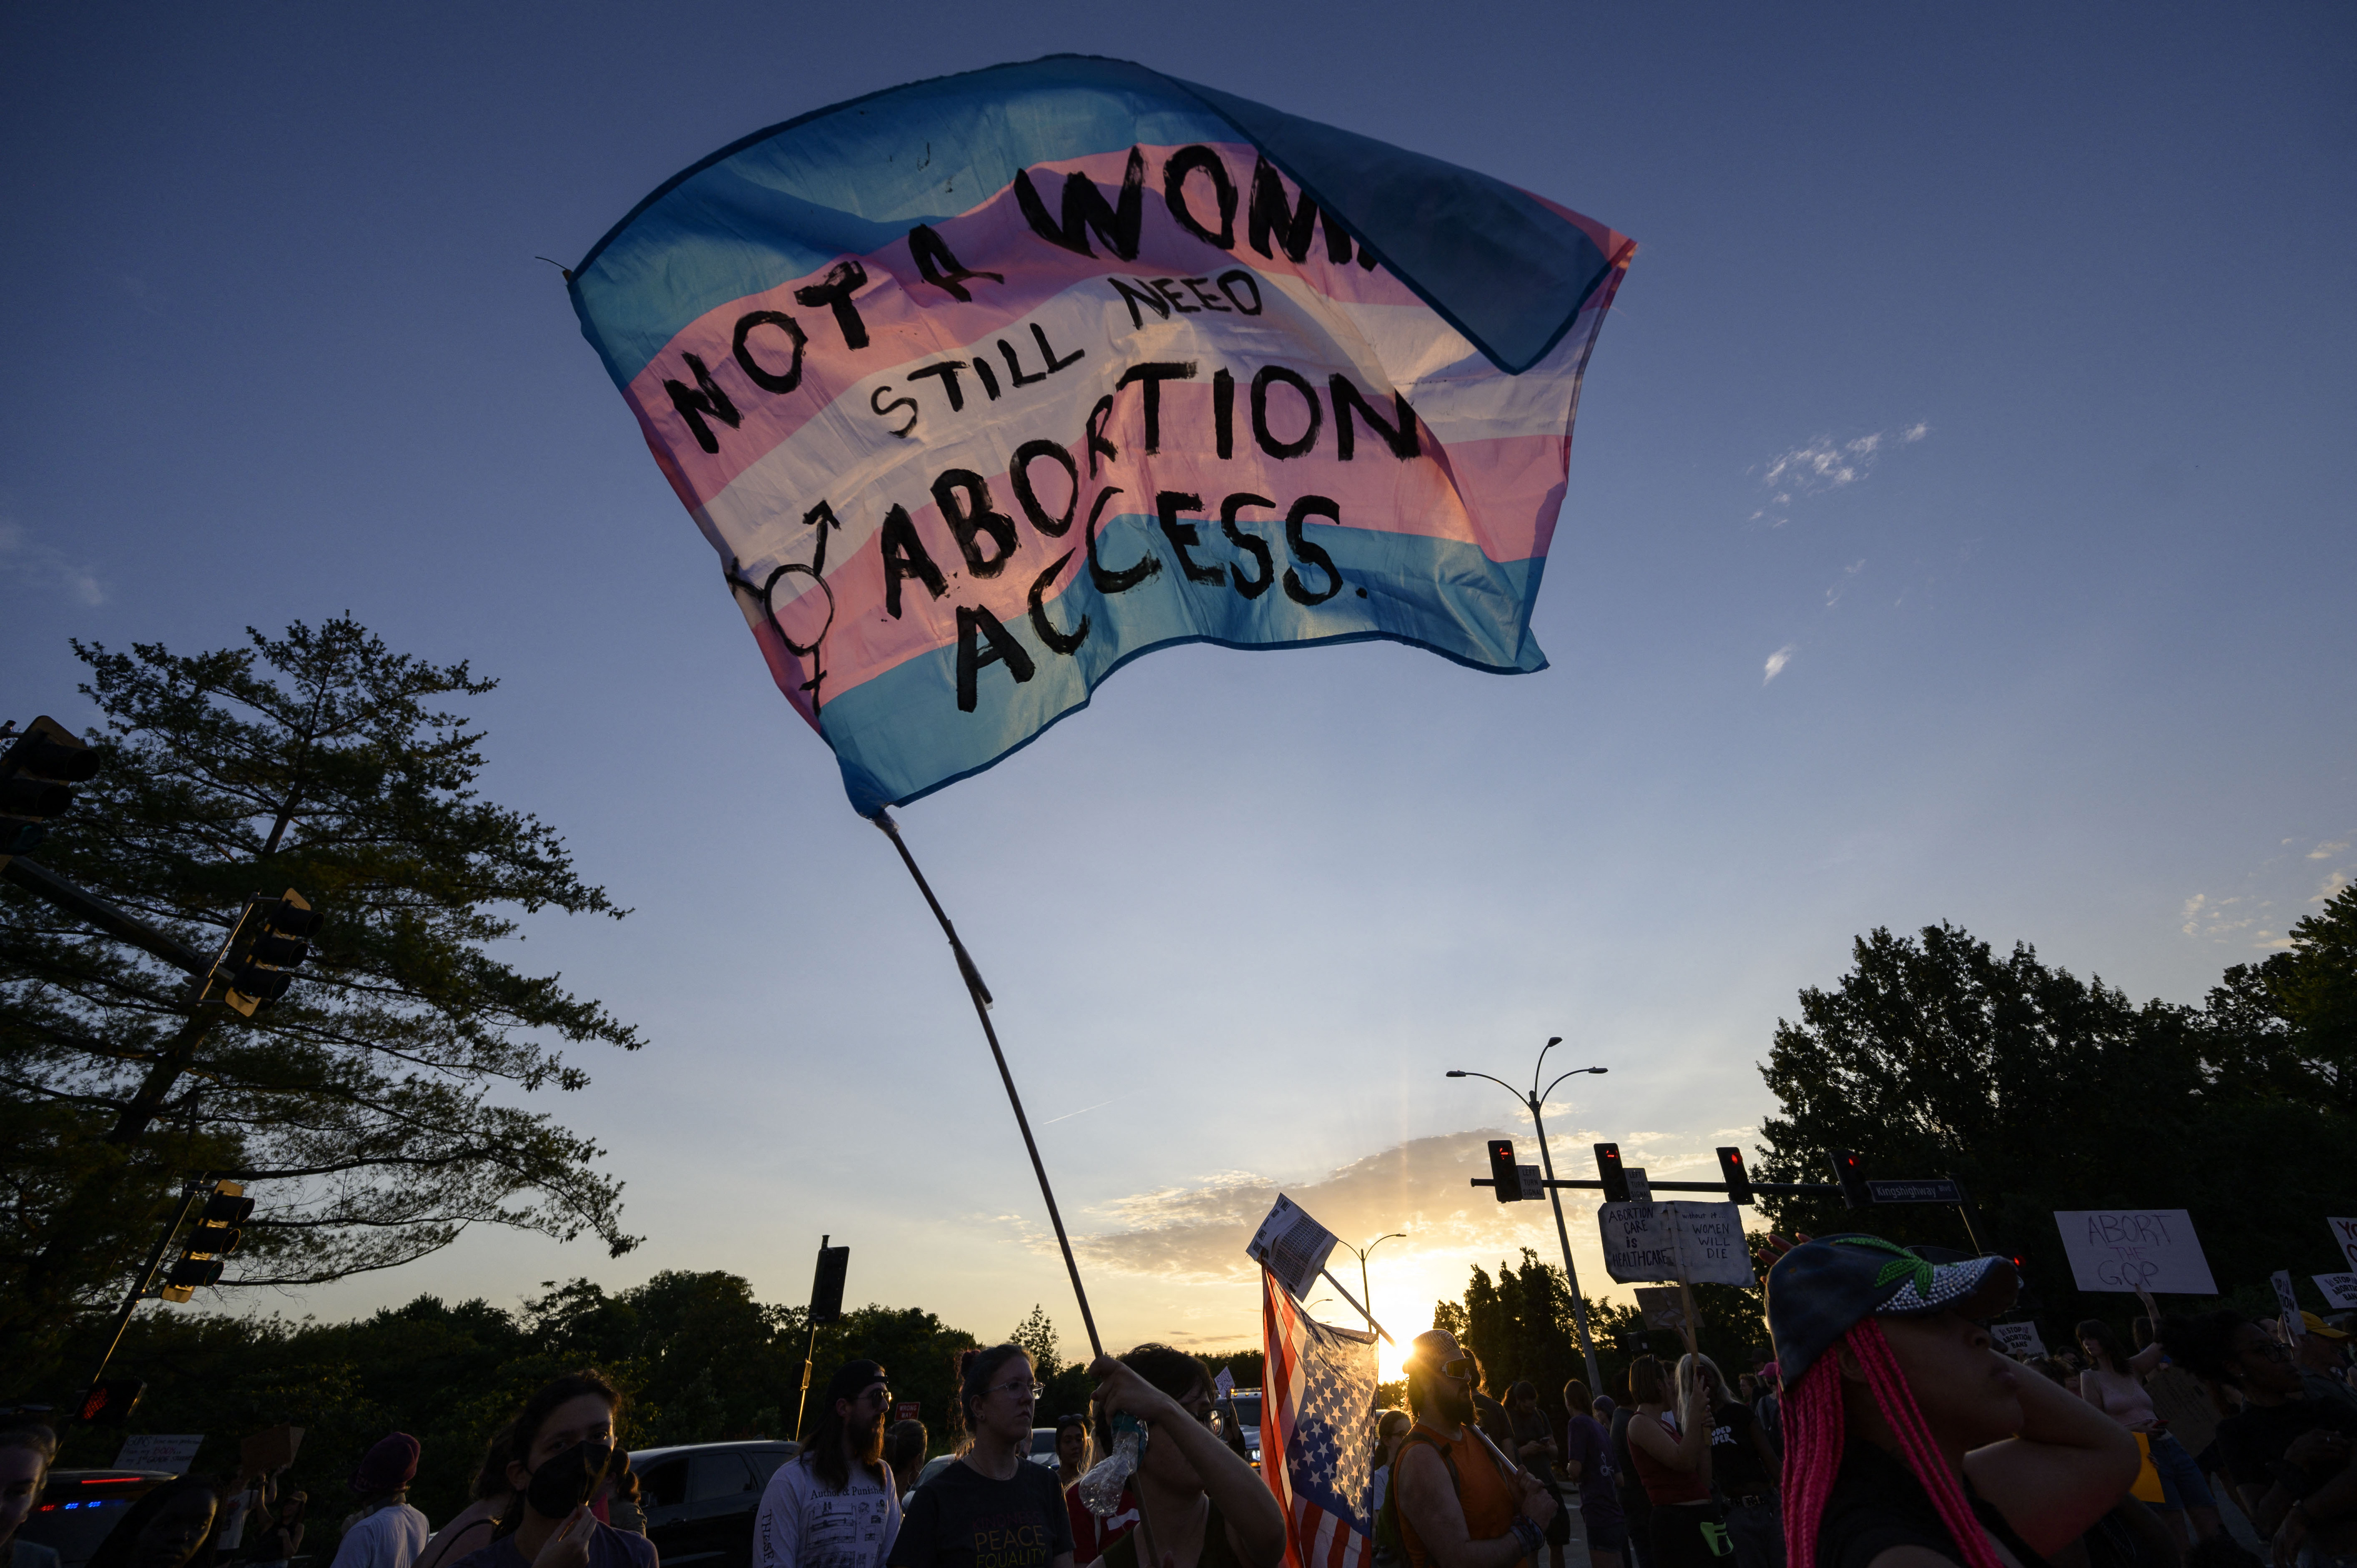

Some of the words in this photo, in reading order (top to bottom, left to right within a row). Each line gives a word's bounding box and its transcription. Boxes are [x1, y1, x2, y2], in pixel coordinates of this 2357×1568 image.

[663, 261, 869, 454] NOT
[909, 223, 1004, 302] A
[1014, 145, 1378, 271] WOM
[871, 324, 1084, 438] STILL
[1108, 269, 1262, 330] NEED
[881, 362, 1421, 620] ABORTION
[956, 486, 1368, 712] ACCESS.
[1876, 1187, 1937, 1198] Kingshighway
[1609, 1207, 1654, 1223] ABORTION
[1624, 1220, 1648, 1234] CARE
[1692, 1224, 1729, 1234] WOMEN
[2088, 1214, 2172, 1246] ABORT
[1627, 1237, 1637, 1248] is
[1698, 1237, 1730, 1246] WILL
[1612, 1249, 1667, 1267] HEALTHCARE
[1707, 1249, 1727, 1258] DIE
[2109, 1247, 2146, 1261] THE
[2098, 1260, 2159, 1287] GOP
[2003, 1334, 2031, 1343] ABORTION
[127, 1436, 152, 1446] GUNS
[811, 1488, 839, 1500] Author
[842, 1487, 849, 1496] &
[852, 1486, 886, 1496] Punisher
[972, 1511, 1041, 1530] KINDNESS
[762, 1509, 774, 1563] THESE
[974, 1525, 1045, 1553] PEACE
